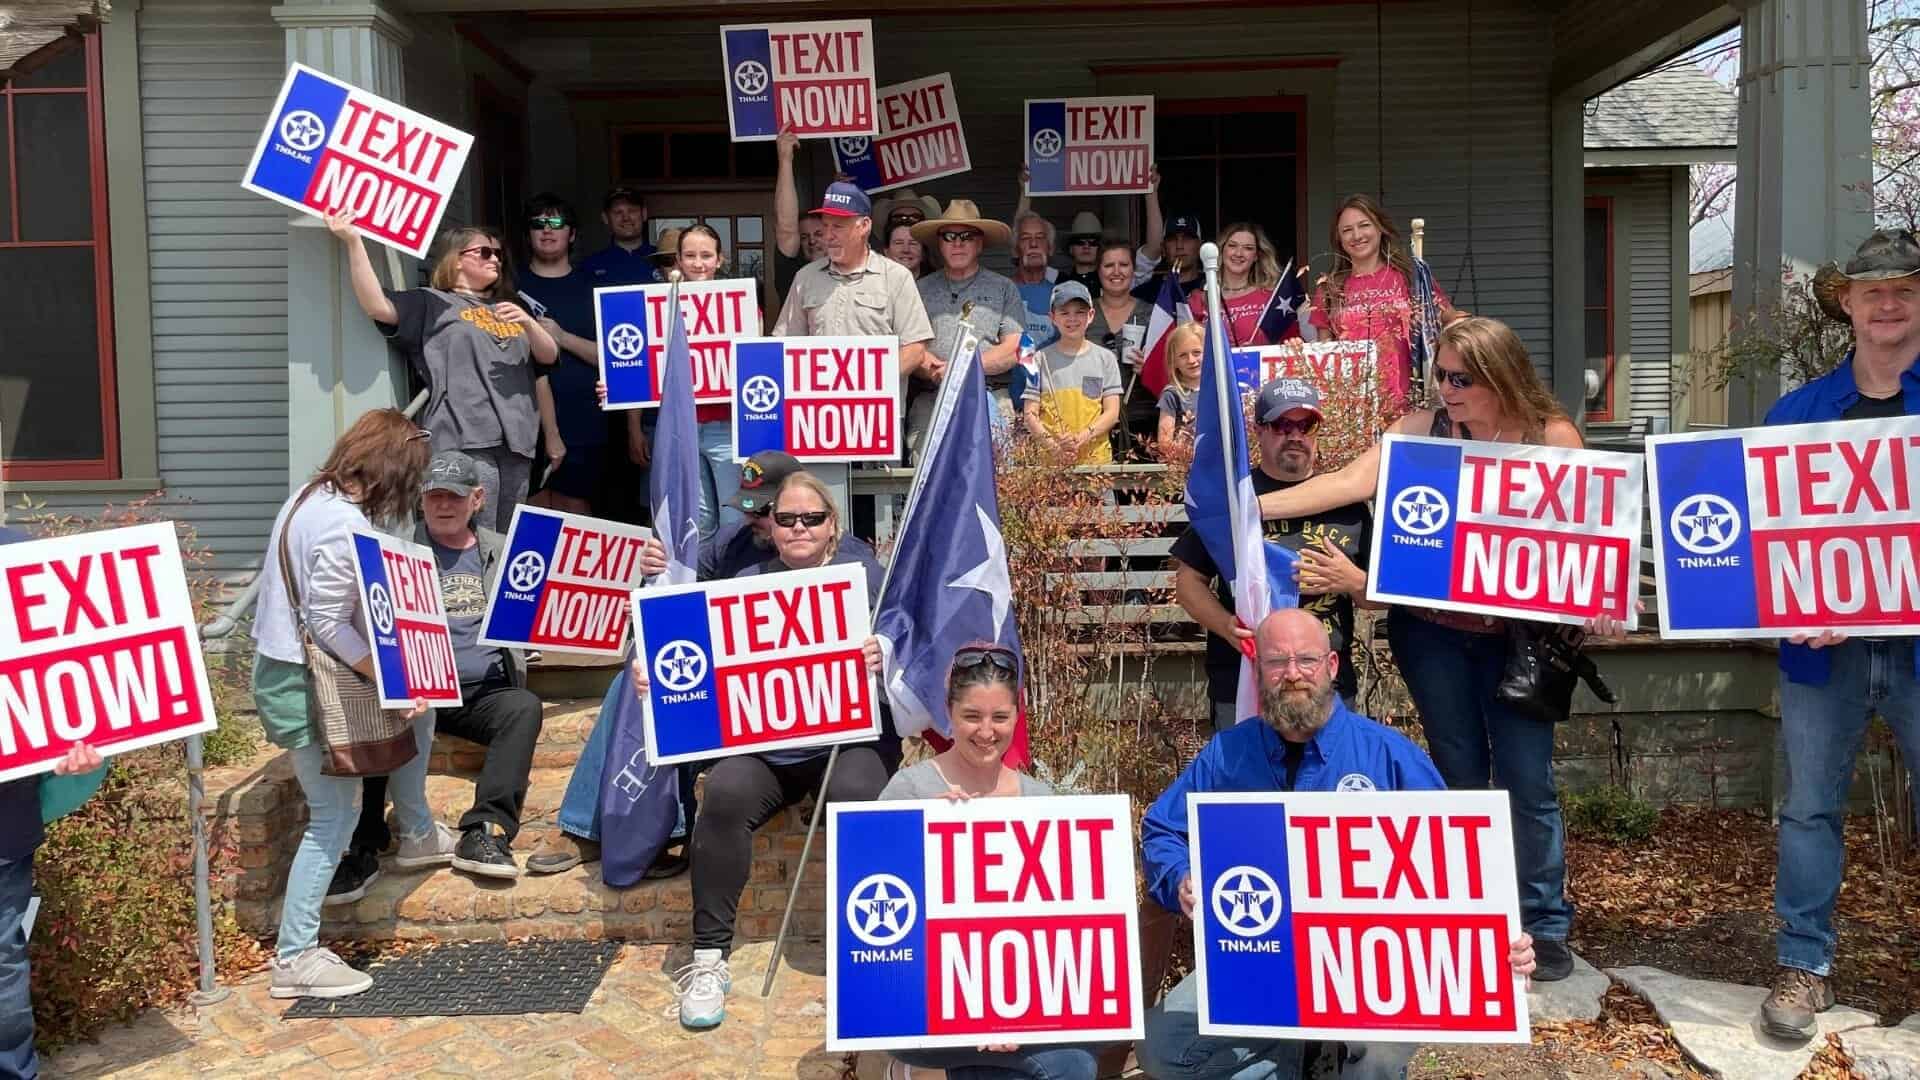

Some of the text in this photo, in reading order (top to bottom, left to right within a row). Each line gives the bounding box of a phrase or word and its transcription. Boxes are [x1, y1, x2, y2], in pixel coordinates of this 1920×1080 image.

[771, 32, 863, 75] TEXIT
[780, 84, 866, 128] NOW!
[1067, 105, 1146, 141] TEXIT
[340, 99, 458, 183] TEXIT
[880, 128, 960, 180] NOW!
[1070, 150, 1144, 185] NOW!
[313, 158, 431, 241] NOW!
[786, 348, 888, 392] TEXIT
[792, 404, 888, 450] NOW!
[1464, 455, 1626, 527] TEXIT
[558, 526, 644, 582] TEXIT
[1304, 521, 1350, 546] BACK
[1392, 534, 1444, 548] TNM.ME
[383, 550, 439, 616] TEXIT
[1462, 532, 1618, 610] NOW!
[1677, 556, 1740, 568] TNM.ME
[6, 544, 160, 644] EXIT
[538, 588, 626, 642] NOW!
[710, 580, 851, 656] TEXIT
[401, 628, 454, 690] NOW!
[0, 640, 188, 756] NOW!
[661, 690, 708, 704] TNM.ME
[726, 659, 862, 736] NOW!
[928, 819, 1114, 904] TEXIT
[1290, 816, 1491, 900] TEXIT
[850, 948, 912, 964] TNM.ME
[940, 928, 1118, 1020] NOW!
[1218, 939, 1280, 953] TNM.ME
[1308, 926, 1500, 1016] NOW!
